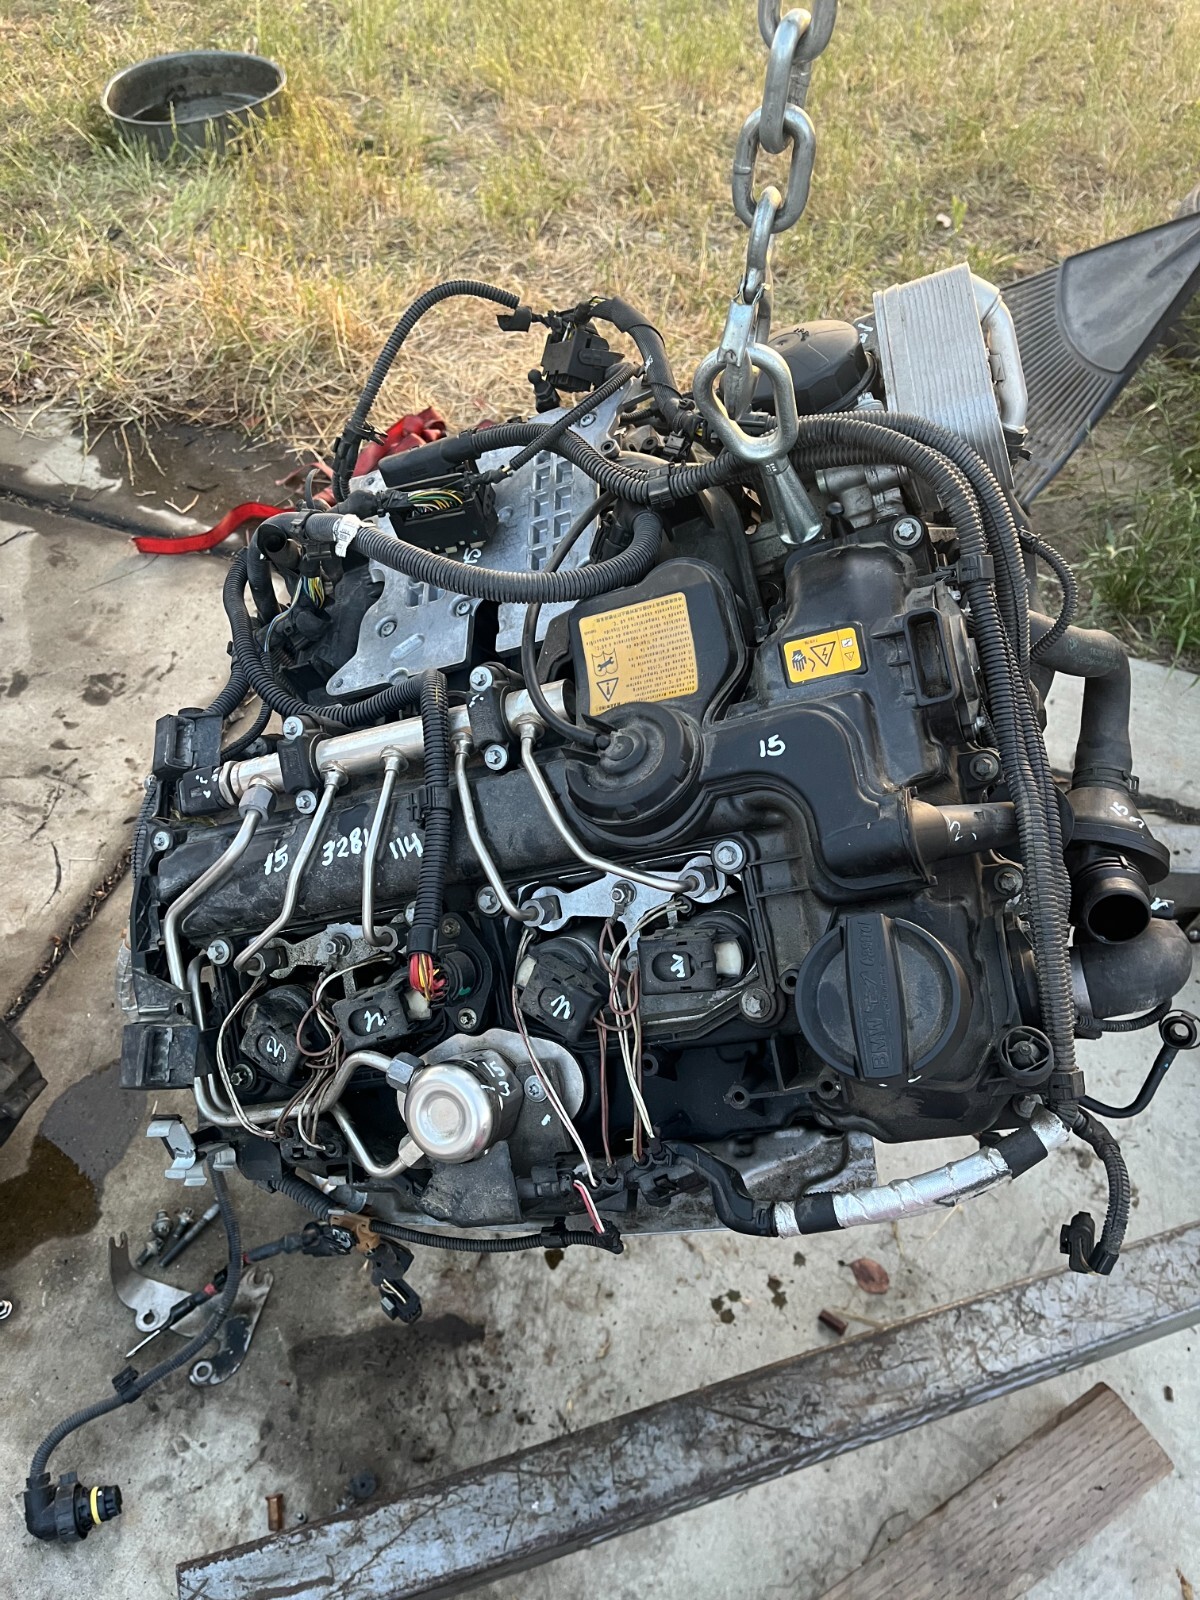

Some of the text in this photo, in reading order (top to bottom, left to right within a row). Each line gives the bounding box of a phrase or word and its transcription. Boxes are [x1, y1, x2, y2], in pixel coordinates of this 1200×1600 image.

[759, 734, 786, 758] 15
[263, 843, 289, 876] 15
[865, 1017, 889, 1070] BMW
